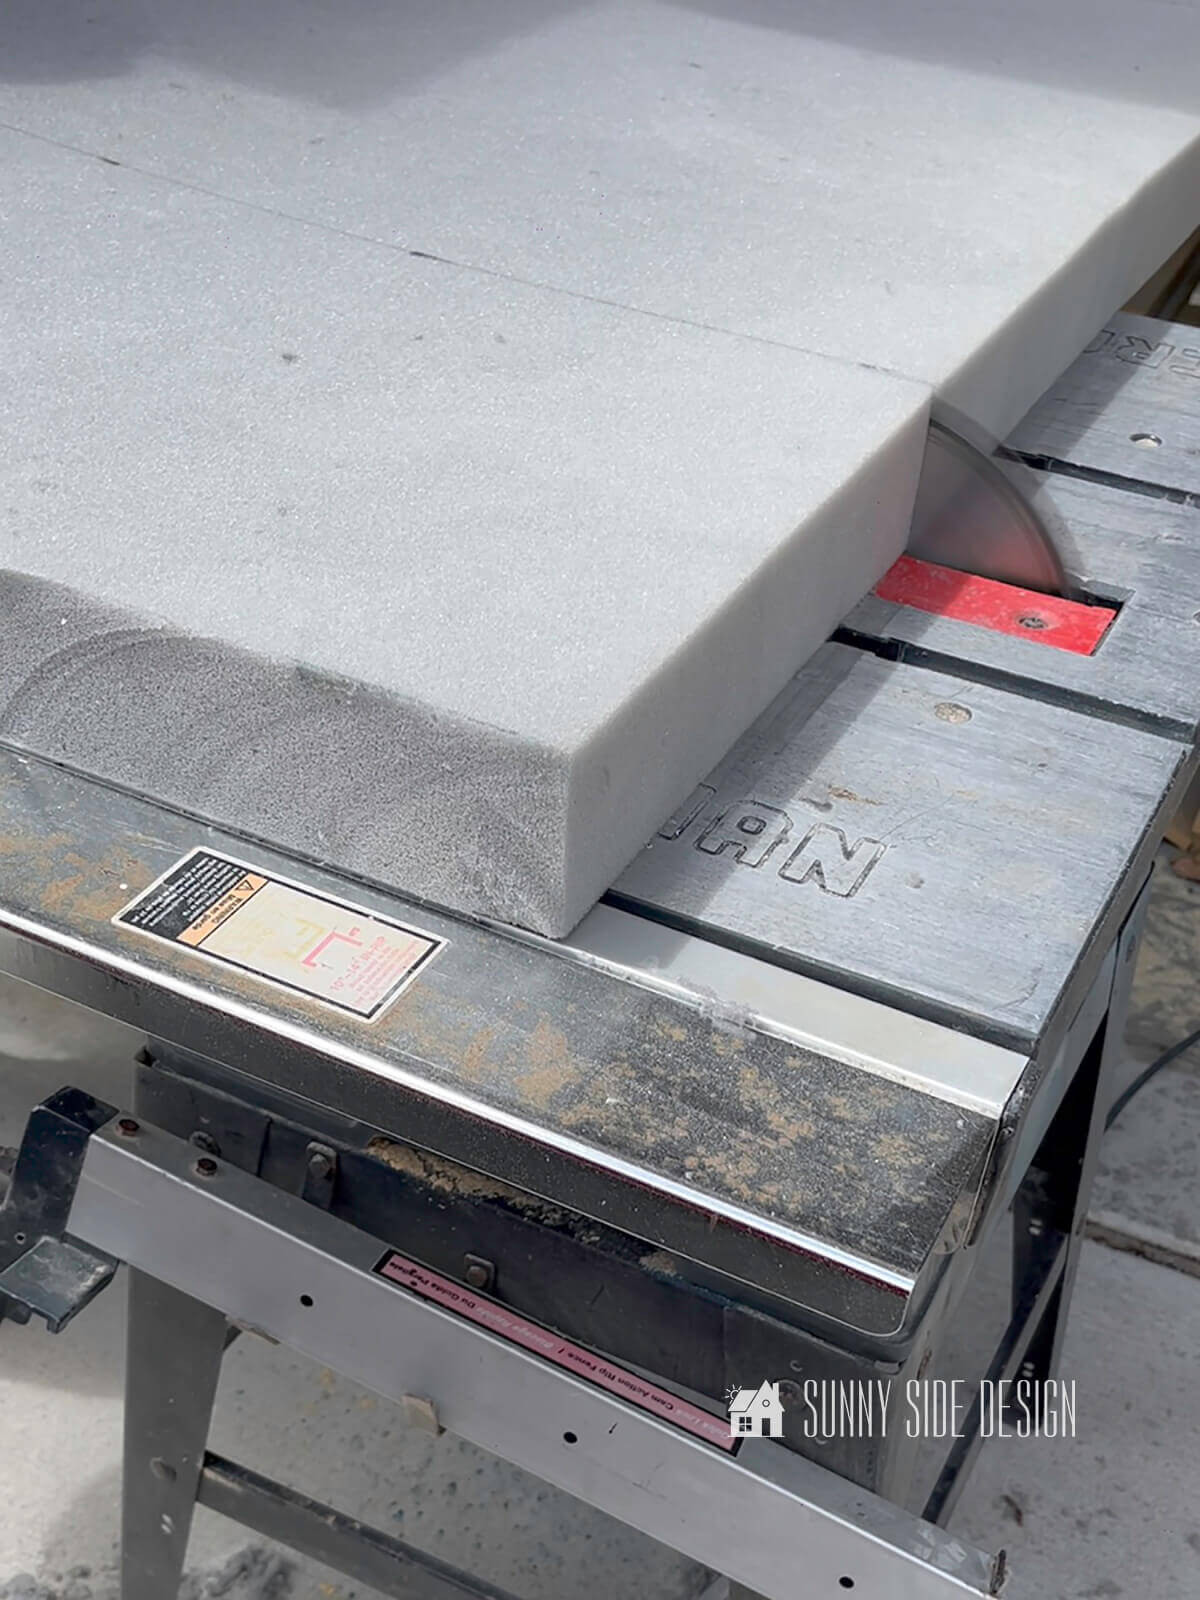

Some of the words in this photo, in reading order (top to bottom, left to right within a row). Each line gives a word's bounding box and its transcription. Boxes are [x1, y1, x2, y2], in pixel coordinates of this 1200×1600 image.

[568, 1352, 598, 1371] Fence
[599, 1367, 615, 1382] Rip
[618, 1378, 650, 1397] Action
[651, 1394, 674, 1411] Cam
